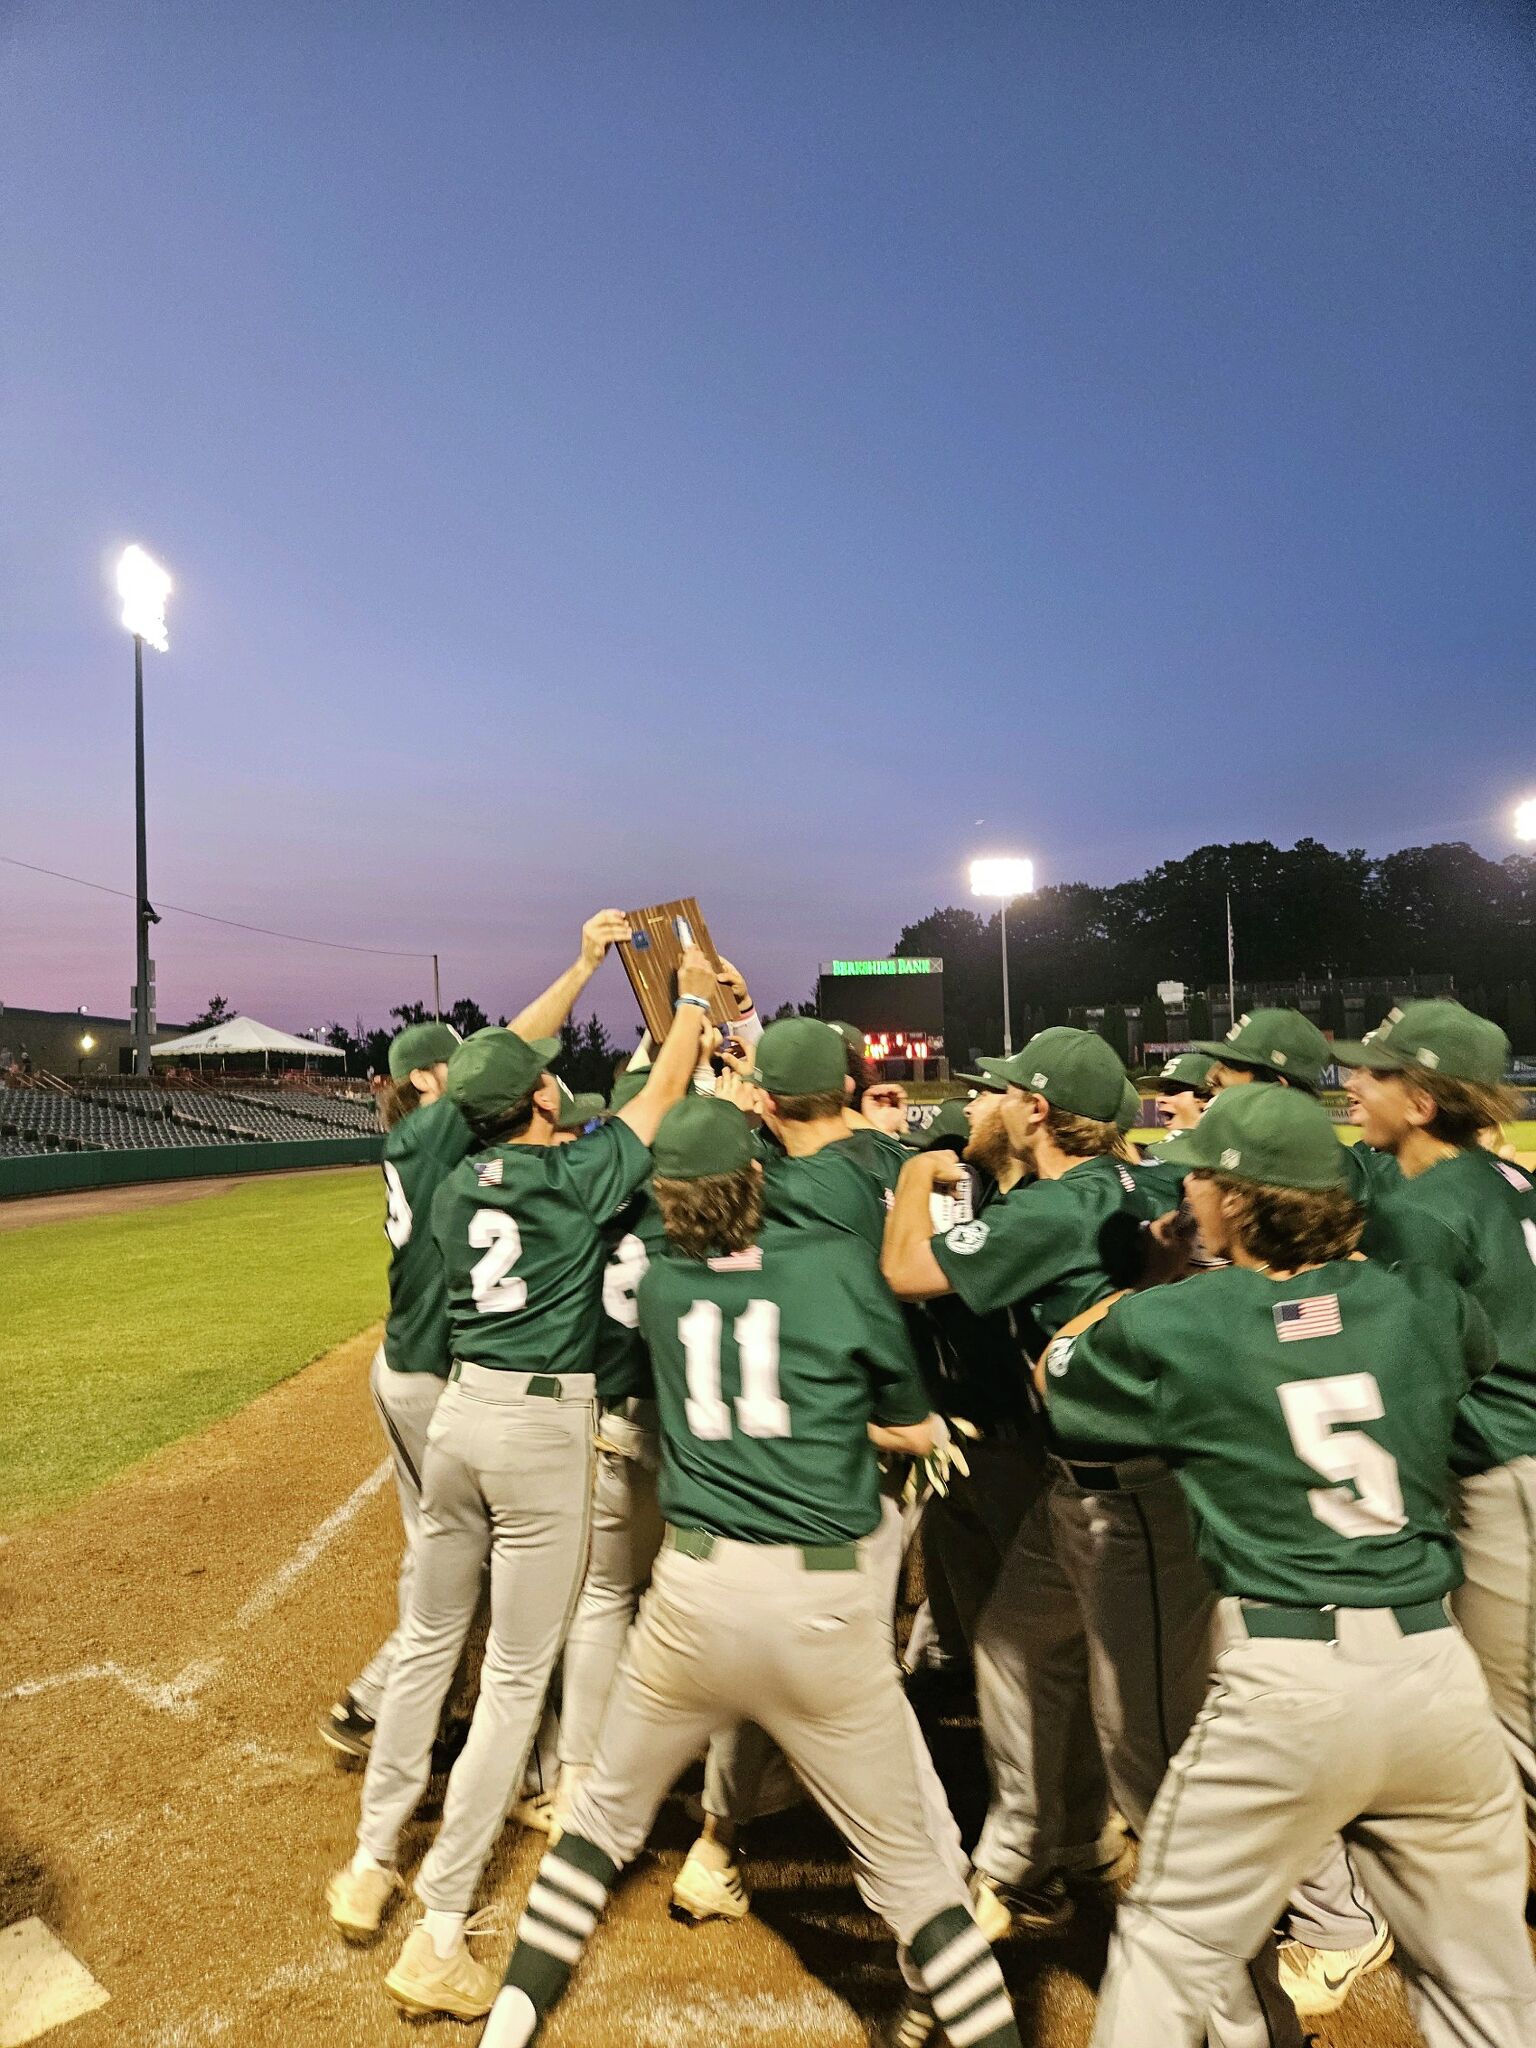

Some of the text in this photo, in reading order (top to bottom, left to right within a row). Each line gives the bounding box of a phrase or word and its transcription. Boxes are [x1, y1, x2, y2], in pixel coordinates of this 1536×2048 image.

[468, 1208, 528, 1313] 2
[677, 1299, 792, 1441] 11
[1275, 1371, 1409, 1539] 5
